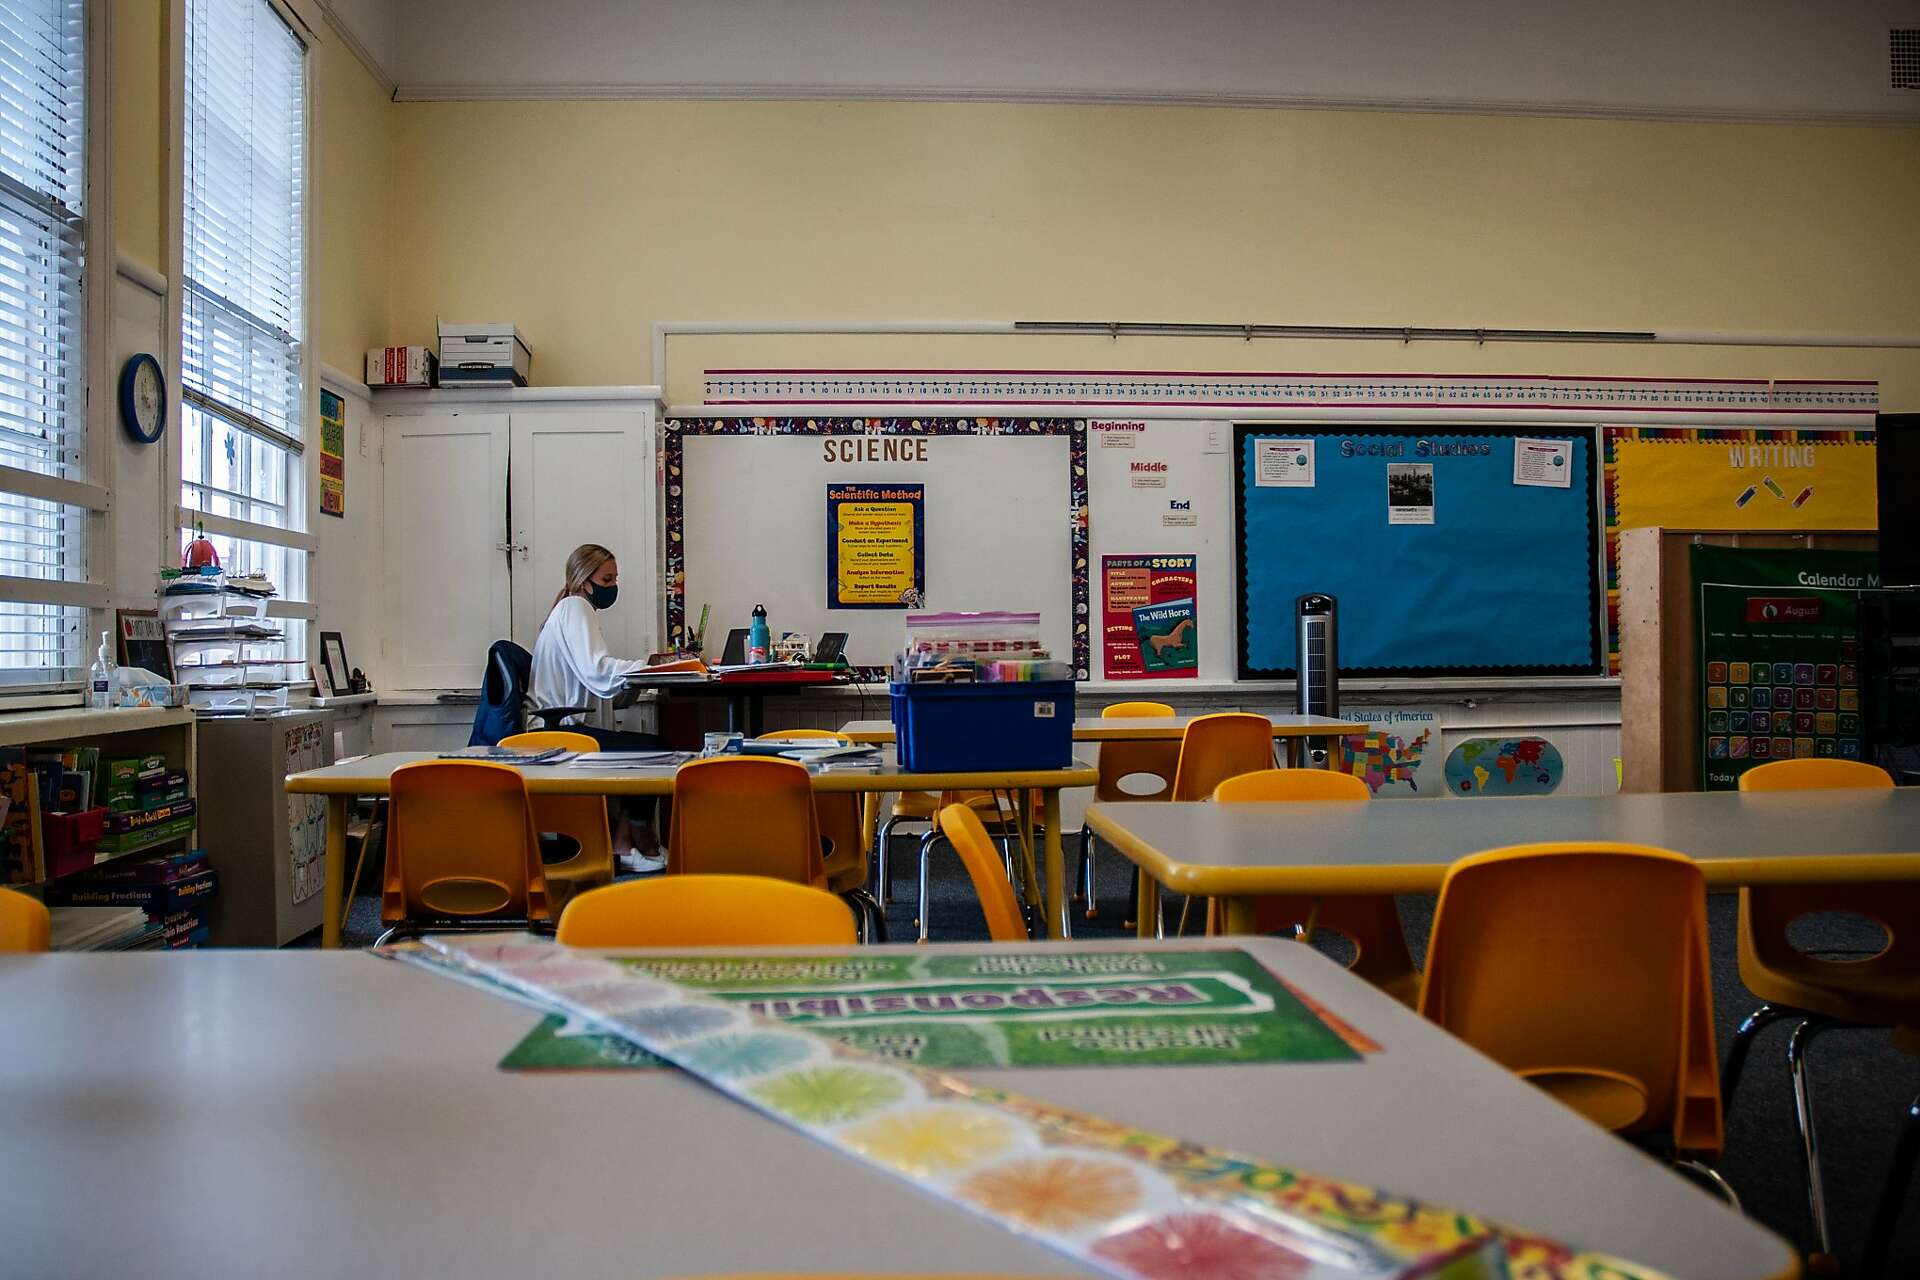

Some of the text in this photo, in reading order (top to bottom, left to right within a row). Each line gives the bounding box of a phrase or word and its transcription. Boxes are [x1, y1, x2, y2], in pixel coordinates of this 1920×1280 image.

[1091, 421, 1145, 431] Beginning
[823, 438, 929, 462] SCIENCE
[1340, 439, 1492, 457] Social Studies
[1728, 445, 1816, 468] WRITING
[1130, 462, 1168, 472] Middle
[829, 489, 922, 500] Scientific Method
[1170, 500, 1190, 510] End
[1152, 558, 1192, 568] STORY
[1798, 571, 1863, 587] Calendar
[1139, 608, 1190, 622] The Wild Horse
[1784, 605, 1819, 617] August
[1734, 693, 1811, 704] 10 11 12 13
[1354, 711, 1382, 723] States
[1384, 711, 1393, 725] of
[1394, 711, 1433, 722] America
[1734, 717, 1745, 726] 17
[1756, 718, 1767, 728] 18
[1755, 743, 1767, 753] 25
[1709, 772, 1735, 783] Today
[72, 890, 152, 902] Building Fractions
[748, 984, 1209, 1018] Responsibil
[1041, 1027, 1176, 1043] control
[1078, 1037, 1238, 1050] Practice
